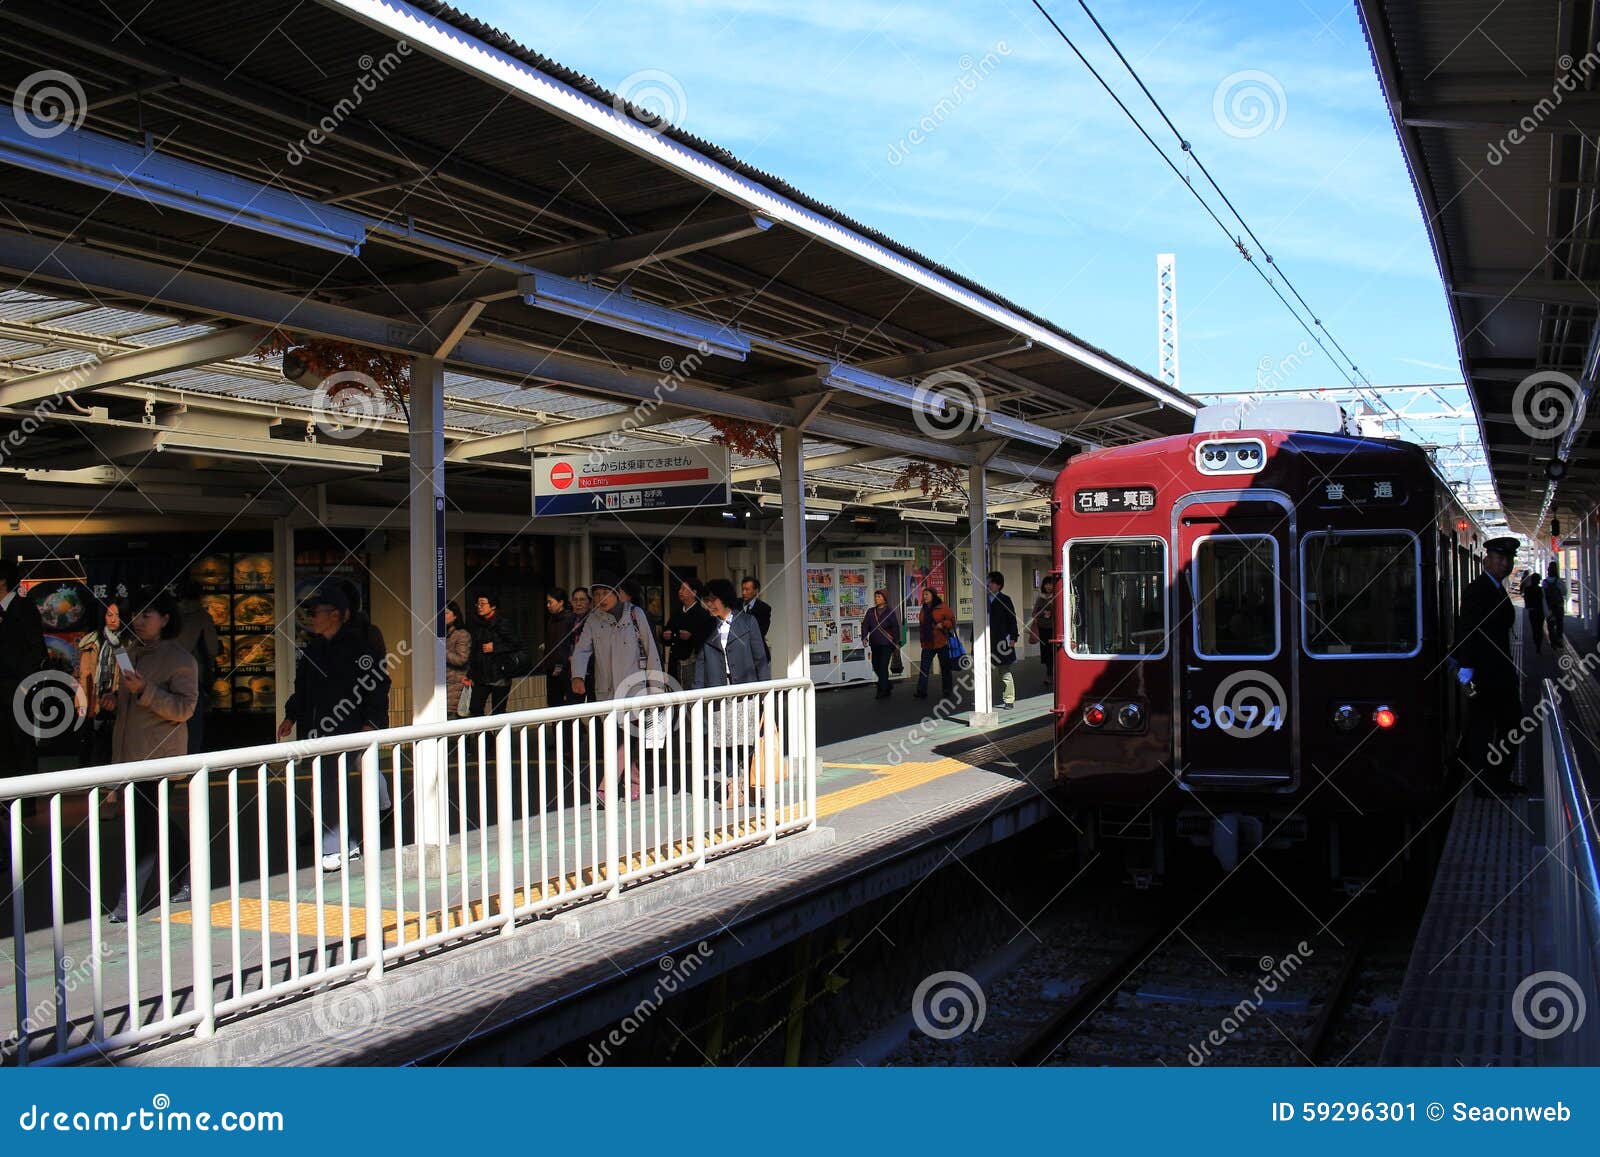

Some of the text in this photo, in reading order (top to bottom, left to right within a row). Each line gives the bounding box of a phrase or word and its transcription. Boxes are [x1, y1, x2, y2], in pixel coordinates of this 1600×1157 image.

[582, 455, 693, 473] ここからは乗車できません
[582, 477, 609, 487] No Entry
[1325, 481, 1394, 500] 普通
[1191, 705, 1284, 732] 3074
